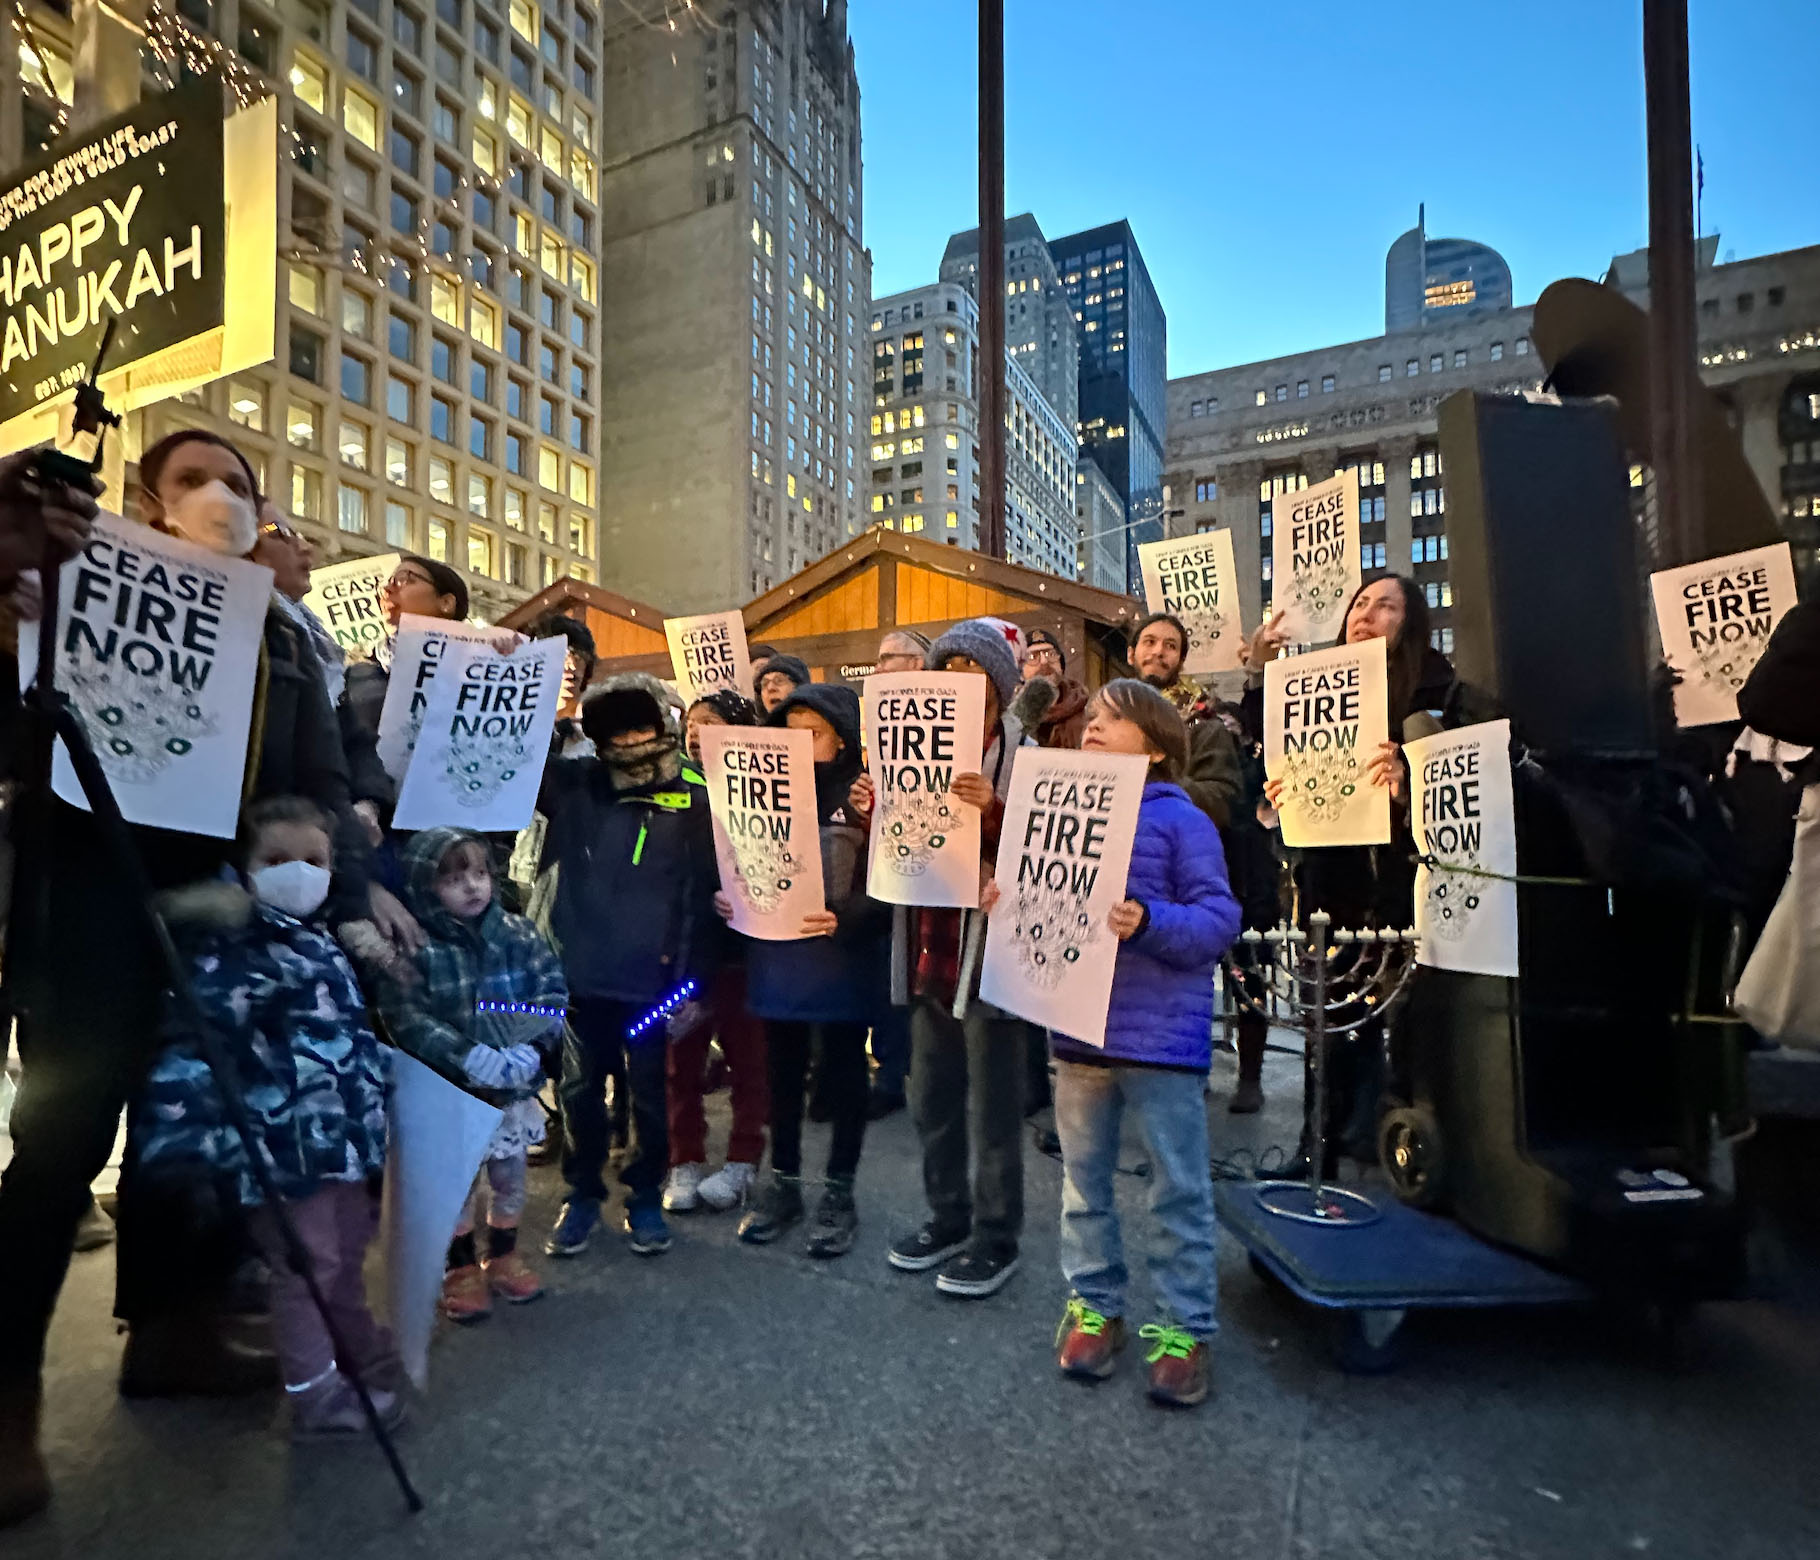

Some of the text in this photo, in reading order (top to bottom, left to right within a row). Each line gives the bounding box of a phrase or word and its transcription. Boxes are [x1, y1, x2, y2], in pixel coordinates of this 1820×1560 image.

[0, 225, 201, 376] ANUKAH
[1292, 492, 1344, 523] CEASE
[1292, 512, 1345, 550] FIRE
[1157, 548, 1215, 572] CEASE
[1292, 539, 1345, 573] NOW
[83, 540, 225, 611] CEASE
[1159, 565, 1218, 595] FIRE
[1683, 568, 1767, 599] CEASE
[71, 567, 220, 657] FIRE
[327, 594, 384, 626] FIR
[1163, 589, 1219, 615] NOW
[1685, 587, 1771, 627] FIRE
[335, 621, 387, 647] NO
[681, 627, 729, 647] CEASE
[1689, 615, 1772, 649] NOW
[65, 617, 213, 691] NOW
[683, 643, 734, 668] FIRE
[465, 661, 545, 682] CEASE
[688, 664, 735, 691] NOW
[841, 665, 875, 677] Germa
[1285, 667, 1360, 697] CEASE
[456, 682, 541, 713] FIRE
[878, 698, 955, 721] CEASE
[1284, 691, 1359, 730] FIRE
[450, 713, 536, 738] NOW
[1283, 724, 1358, 756] NOW
[878, 725, 955, 761] FIRE
[724, 750, 789, 776] CEASE
[1423, 751, 1479, 785] CEASE
[726, 774, 791, 813] FIRE
[881, 765, 952, 794] NOW
[1033, 780, 1116, 812] CEASE
[1423, 780, 1480, 824] FIRE
[728, 809, 791, 842] NOW
[1023, 808, 1108, 860] FIRE
[1424, 822, 1481, 855] NOW
[1017, 854, 1098, 900] NOW
